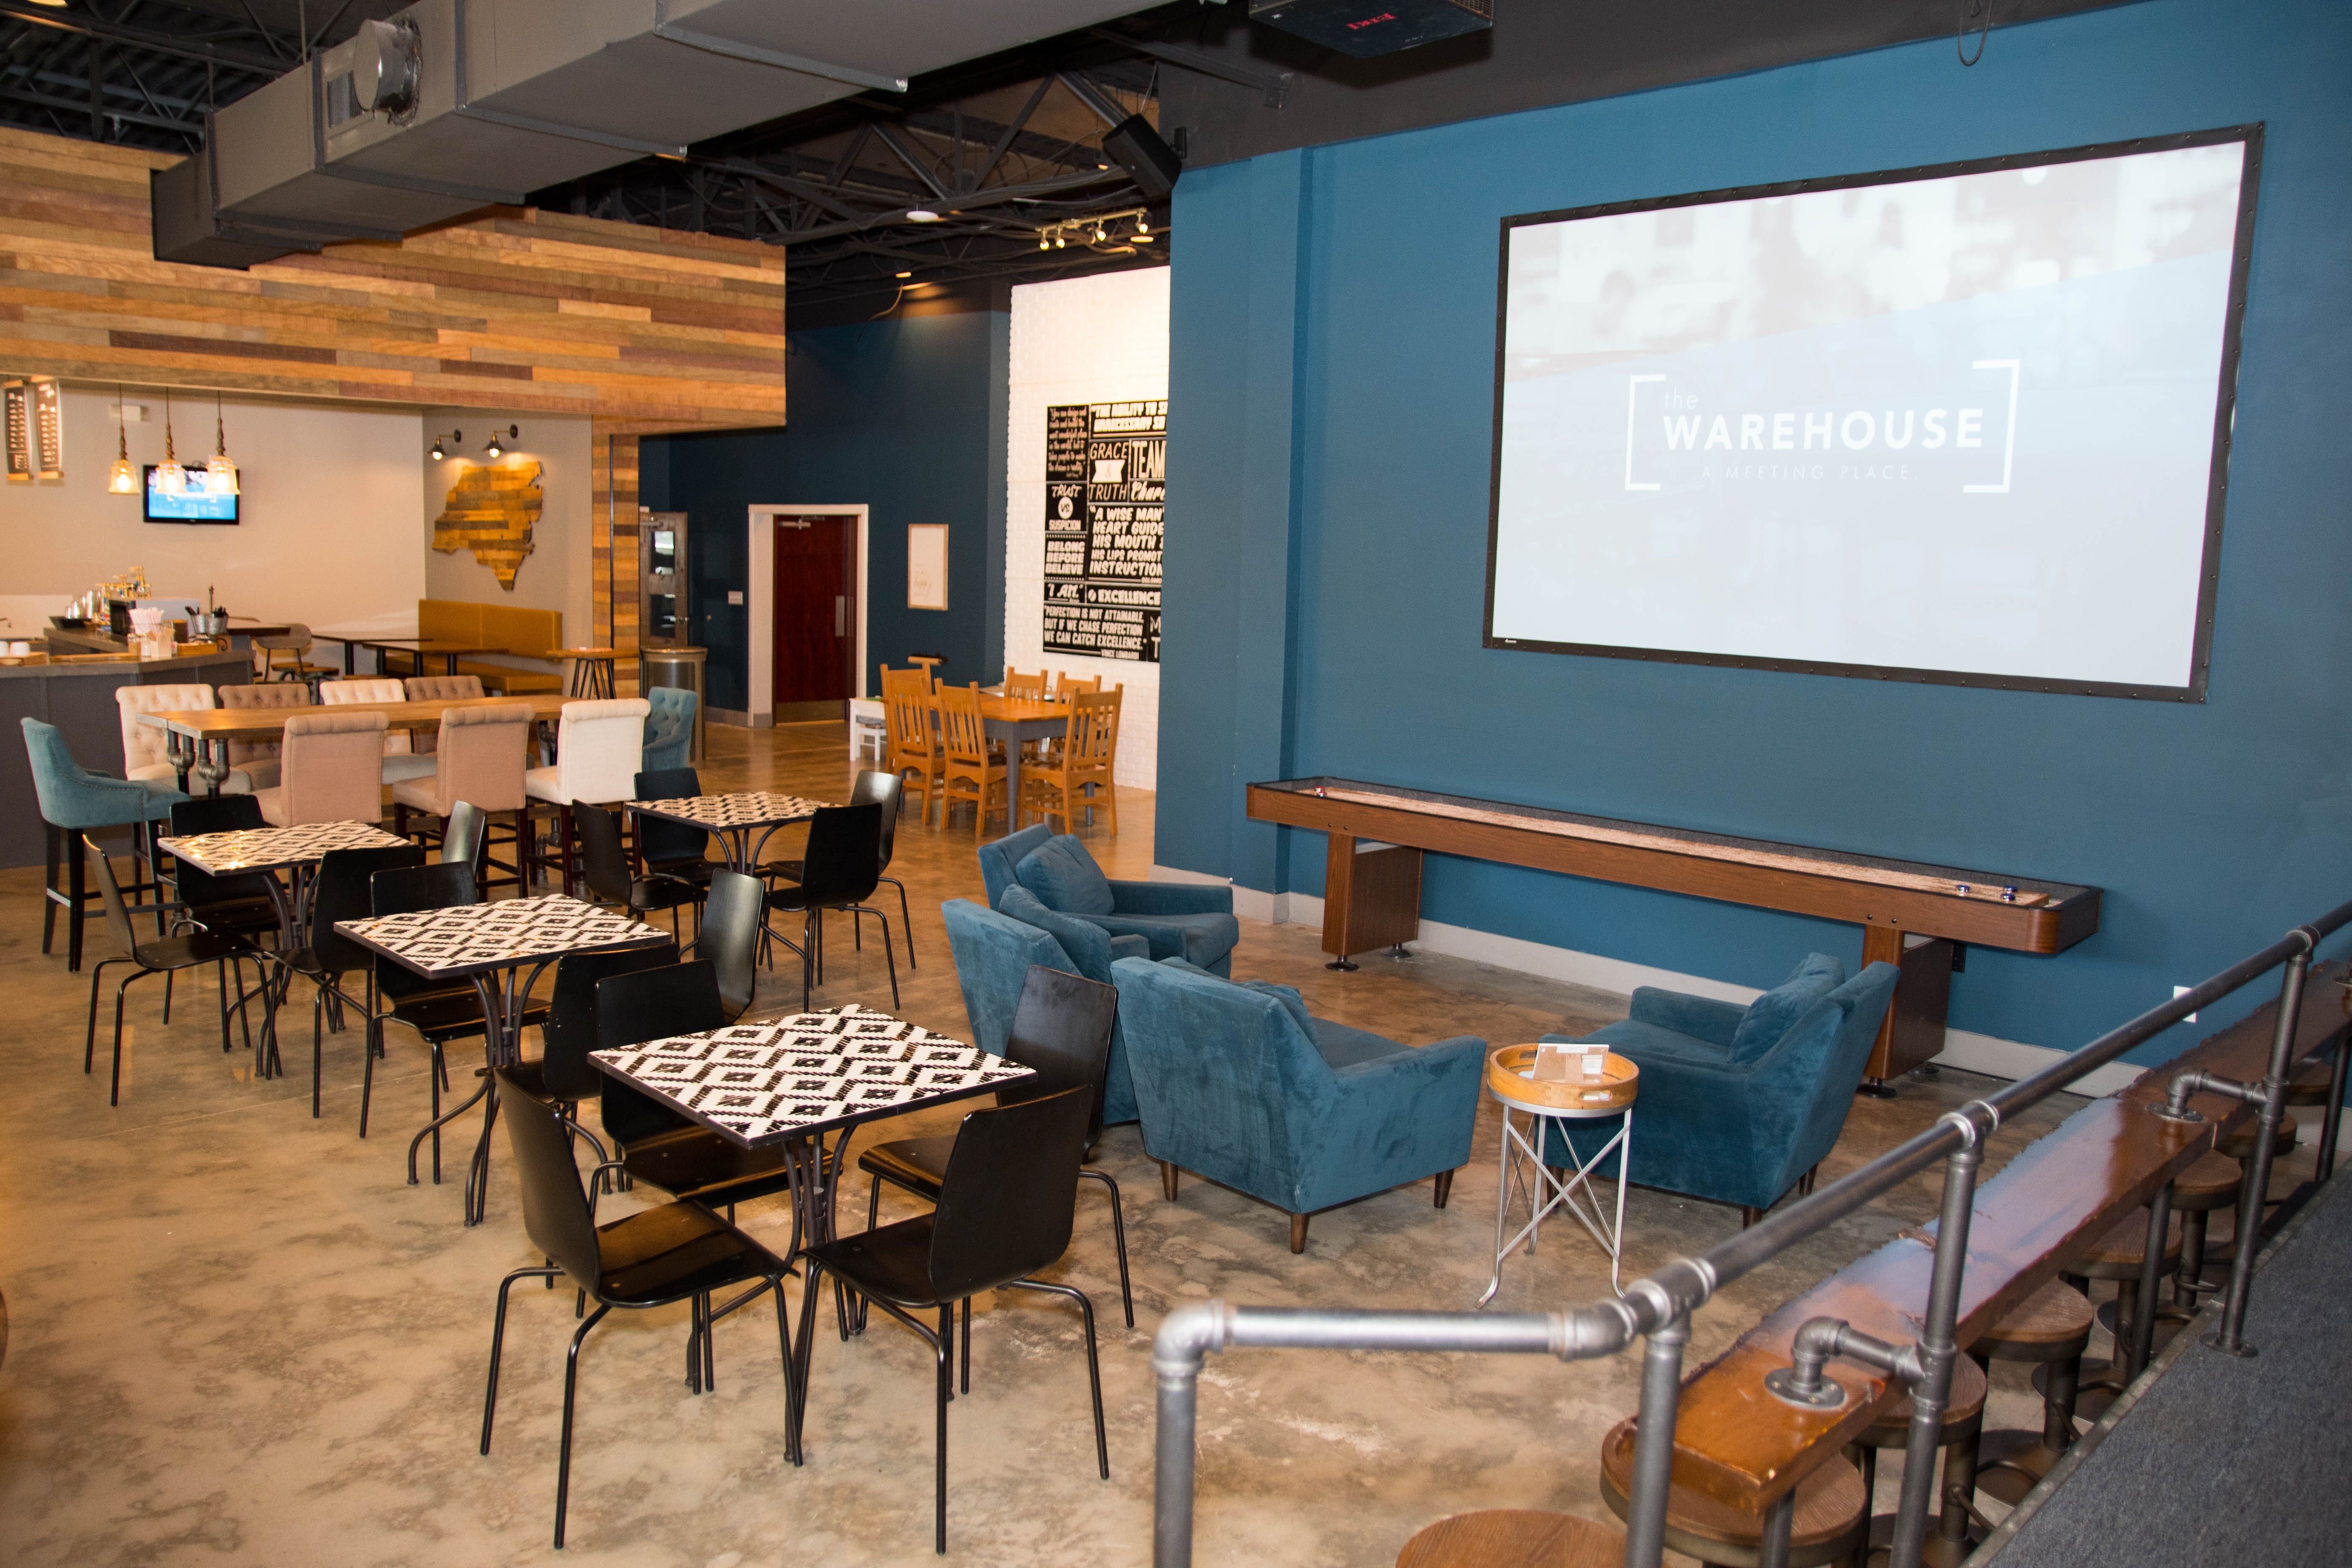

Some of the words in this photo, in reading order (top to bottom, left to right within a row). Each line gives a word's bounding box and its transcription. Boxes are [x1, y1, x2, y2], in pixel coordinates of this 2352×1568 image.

[1665, 385, 1697, 409] the
[1663, 408, 1984, 451] WAREHOUSE
[1090, 442, 1129, 460] GRACE
[1702, 466, 1710, 479] A
[1726, 464, 1825, 480] MEETING
[1051, 484, 1082, 498] TRUST
[1089, 484, 1127, 501] TRUTH
[1106, 507, 1134, 521] WISE
[1049, 519, 1081, 531] SUSPICION
[1092, 521, 1129, 534] HEART
[1131, 521, 1164, 536] GUIDE
[1048, 541, 1085, 552] BELONG
[1092, 534, 1112, 548] HIS
[1114, 534, 1157, 549] MOUTH
[1046, 552, 1084, 564] BEFORE
[1091, 549, 1105, 561] HIS
[1106, 549, 1125, 561] LIPS
[1045, 563, 1083, 574] BELIEVE
[1089, 561, 1162, 576] INSTRUCTION
[1098, 589, 1161, 605] EXCELLENCE
[1081, 607, 1088, 619] IS
[1089, 608, 1103, 620] NOT
[1044, 618, 1058, 629] BUT
[1059, 618, 1065, 630] IF
[1067, 619, 1077, 631] WE
[1078, 620, 1100, 633] CHASE
[1101, 621, 1143, 637] PERFECTION
[1044, 630, 1055, 642] WE
[1056, 631, 1071, 644] CAN
[1072, 632, 1096, 646] CATCH
